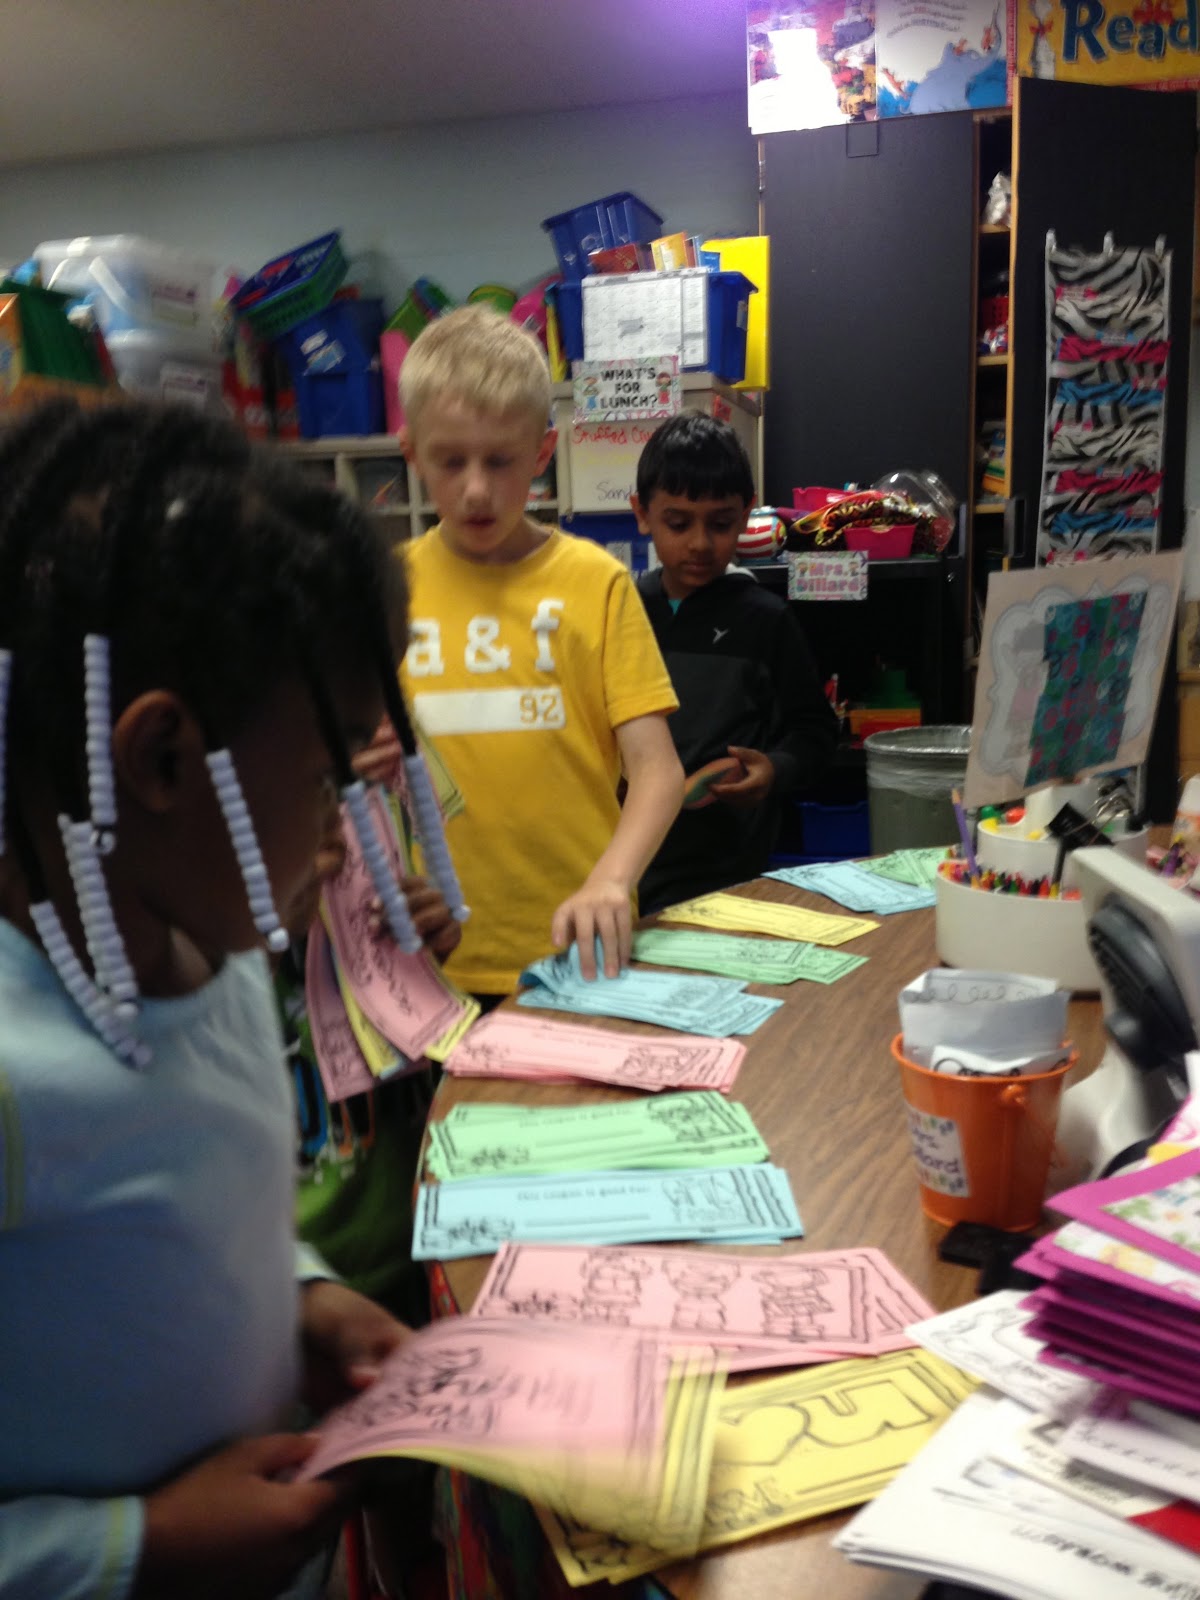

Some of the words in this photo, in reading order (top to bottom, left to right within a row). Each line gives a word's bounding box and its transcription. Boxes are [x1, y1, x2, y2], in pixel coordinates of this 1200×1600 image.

[1061, 0, 1199, 63] Read
[600, 367, 656, 382] WHAT'S
[615, 382, 640, 394] FOR
[600, 393, 658, 409] LUNCH?
[596, 481, 632, 501] Sand
[519, 694, 559, 723] 92
